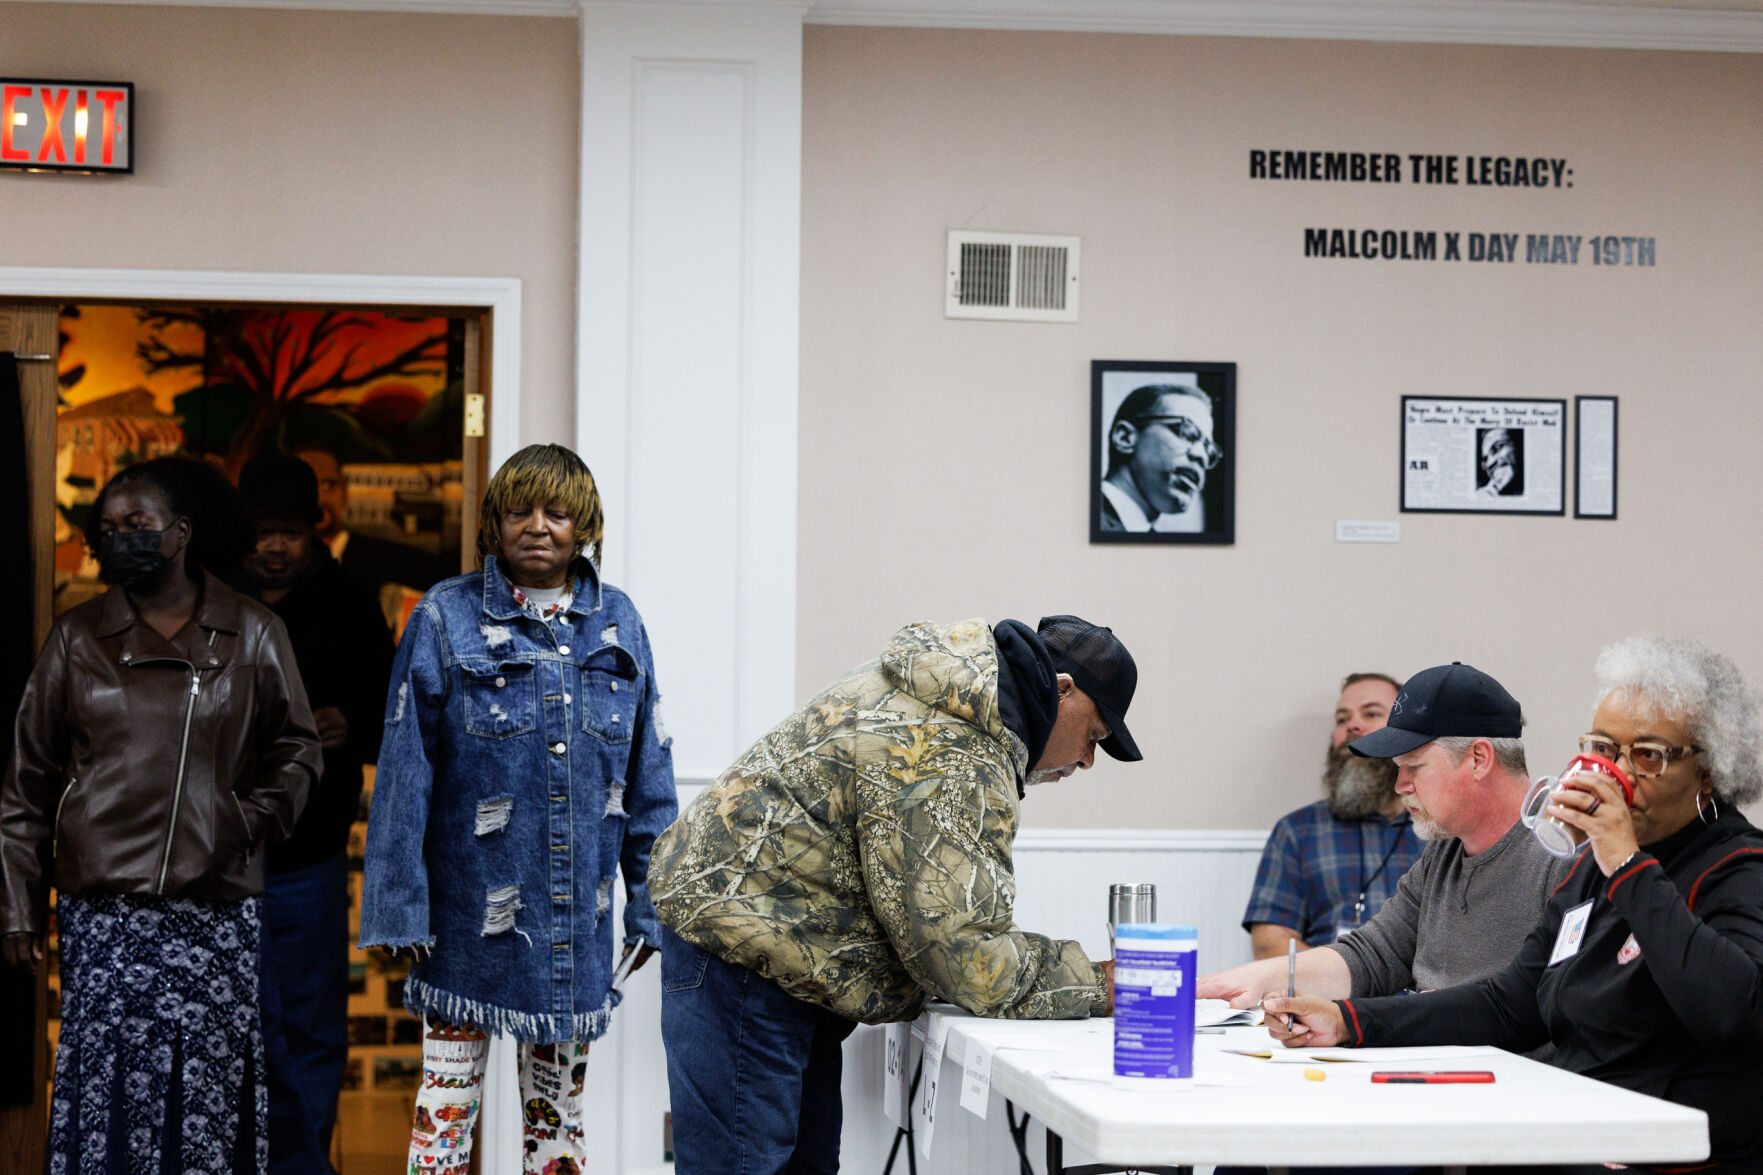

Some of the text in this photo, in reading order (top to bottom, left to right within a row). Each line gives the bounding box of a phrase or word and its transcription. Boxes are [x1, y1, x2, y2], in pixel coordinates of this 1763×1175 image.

[1, 85, 125, 165] EXIT
[1249, 149, 1574, 188] REMEMBER THE LEGACY:
[1304, 228, 1656, 267] MALCOLM X DAY MAY 19TH
